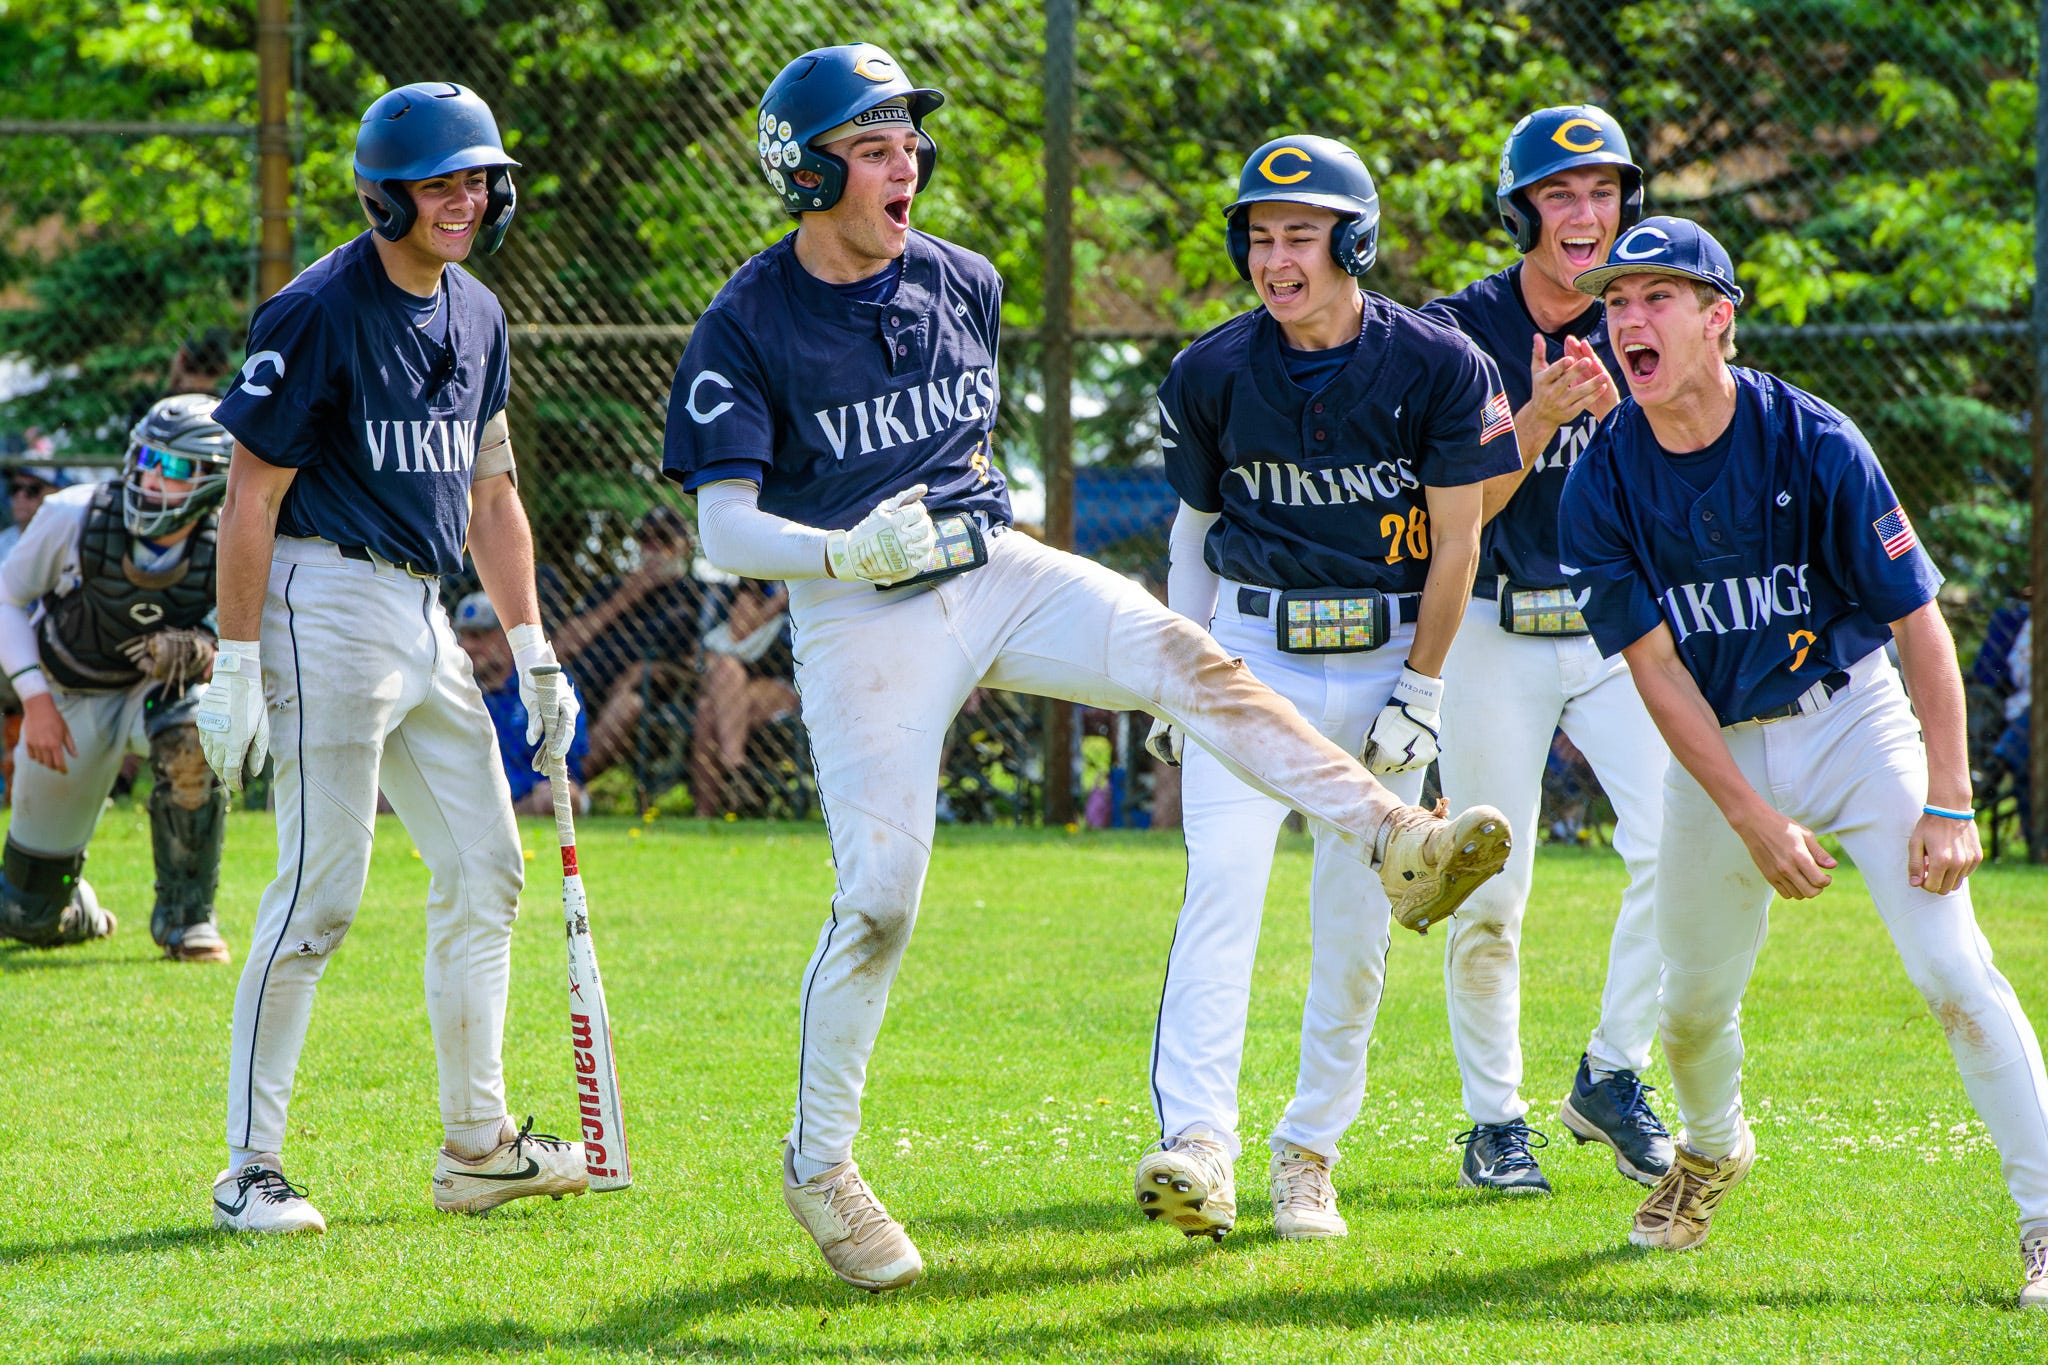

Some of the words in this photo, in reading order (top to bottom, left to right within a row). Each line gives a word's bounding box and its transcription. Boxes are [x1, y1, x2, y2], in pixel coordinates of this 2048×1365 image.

[860, 109, 909, 123] BATTLE
[1551, 118, 1605, 153] C
[1258, 147, 1313, 184] C
[1615, 226, 1670, 260] C
[684, 370, 735, 425] C
[814, 367, 995, 461] VIKINGS
[1230, 457, 1420, 506] VIKINGS
[1380, 505, 1429, 565] 28
[570, 1013, 618, 1178] marucci
